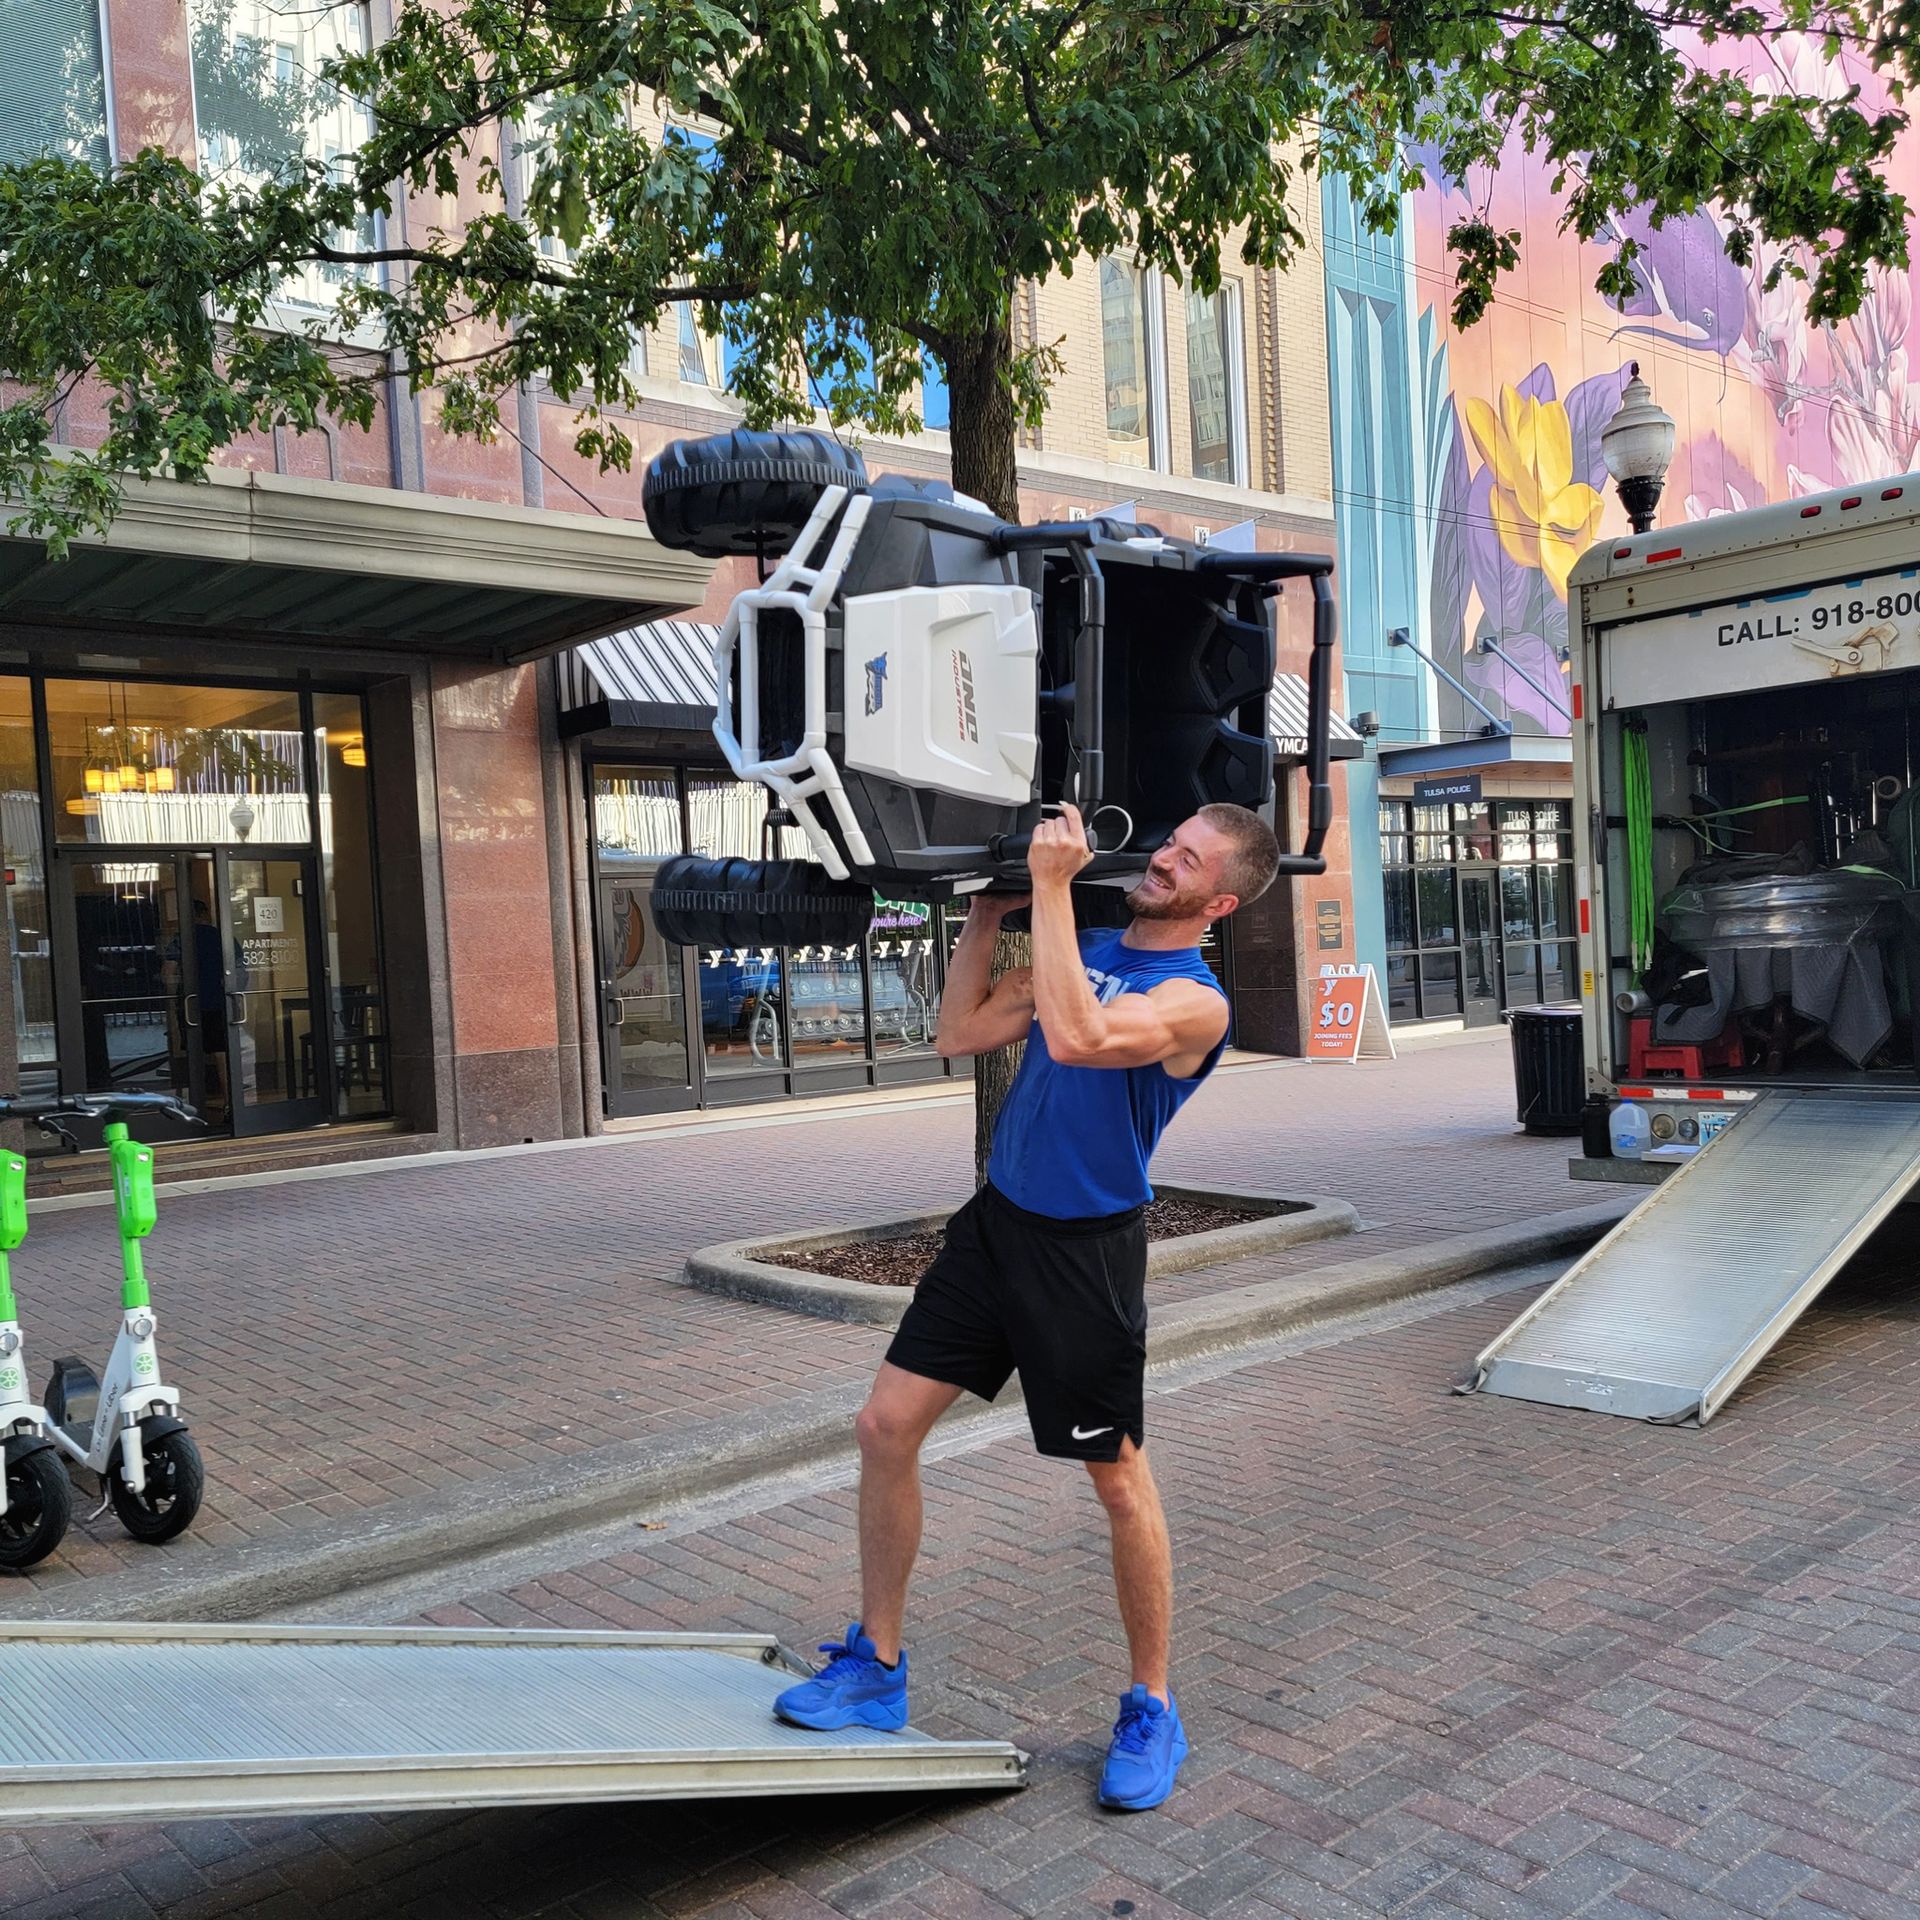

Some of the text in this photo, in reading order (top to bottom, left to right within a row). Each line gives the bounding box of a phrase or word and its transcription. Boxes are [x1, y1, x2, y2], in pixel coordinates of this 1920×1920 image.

[1718, 615, 1800, 647] CALL:
[951, 649, 965, 741] INDUSTRIES
[1275, 737, 1309, 755] YMCA
[1424, 784, 1471, 797] TULSA POLICE
[1506, 810, 1560, 822] TULSA POLICE
[260, 909, 278, 919] 420
[242, 938, 298, 949] APARTMENTS
[242, 950, 299, 965] 582-8100
[1319, 1001, 1354, 1028] $0
